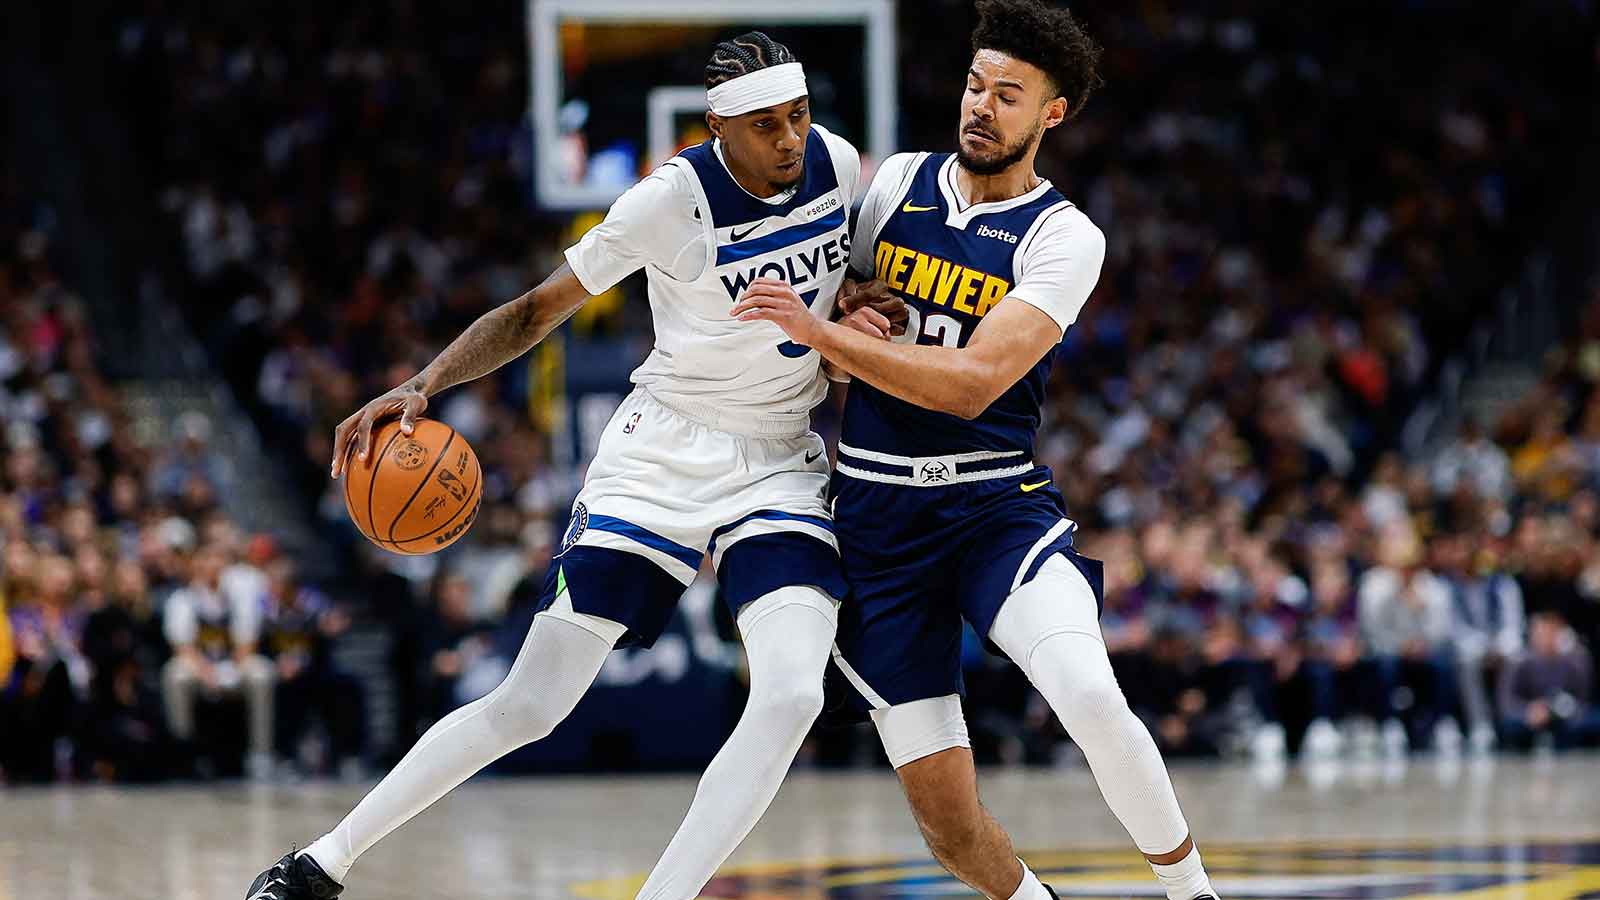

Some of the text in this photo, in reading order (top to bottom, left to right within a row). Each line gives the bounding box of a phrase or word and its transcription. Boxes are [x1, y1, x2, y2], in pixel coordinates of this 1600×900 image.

[811, 198, 837, 215] sezzle
[976, 224, 1018, 244] ibotta
[875, 240, 1009, 318] DENVER
